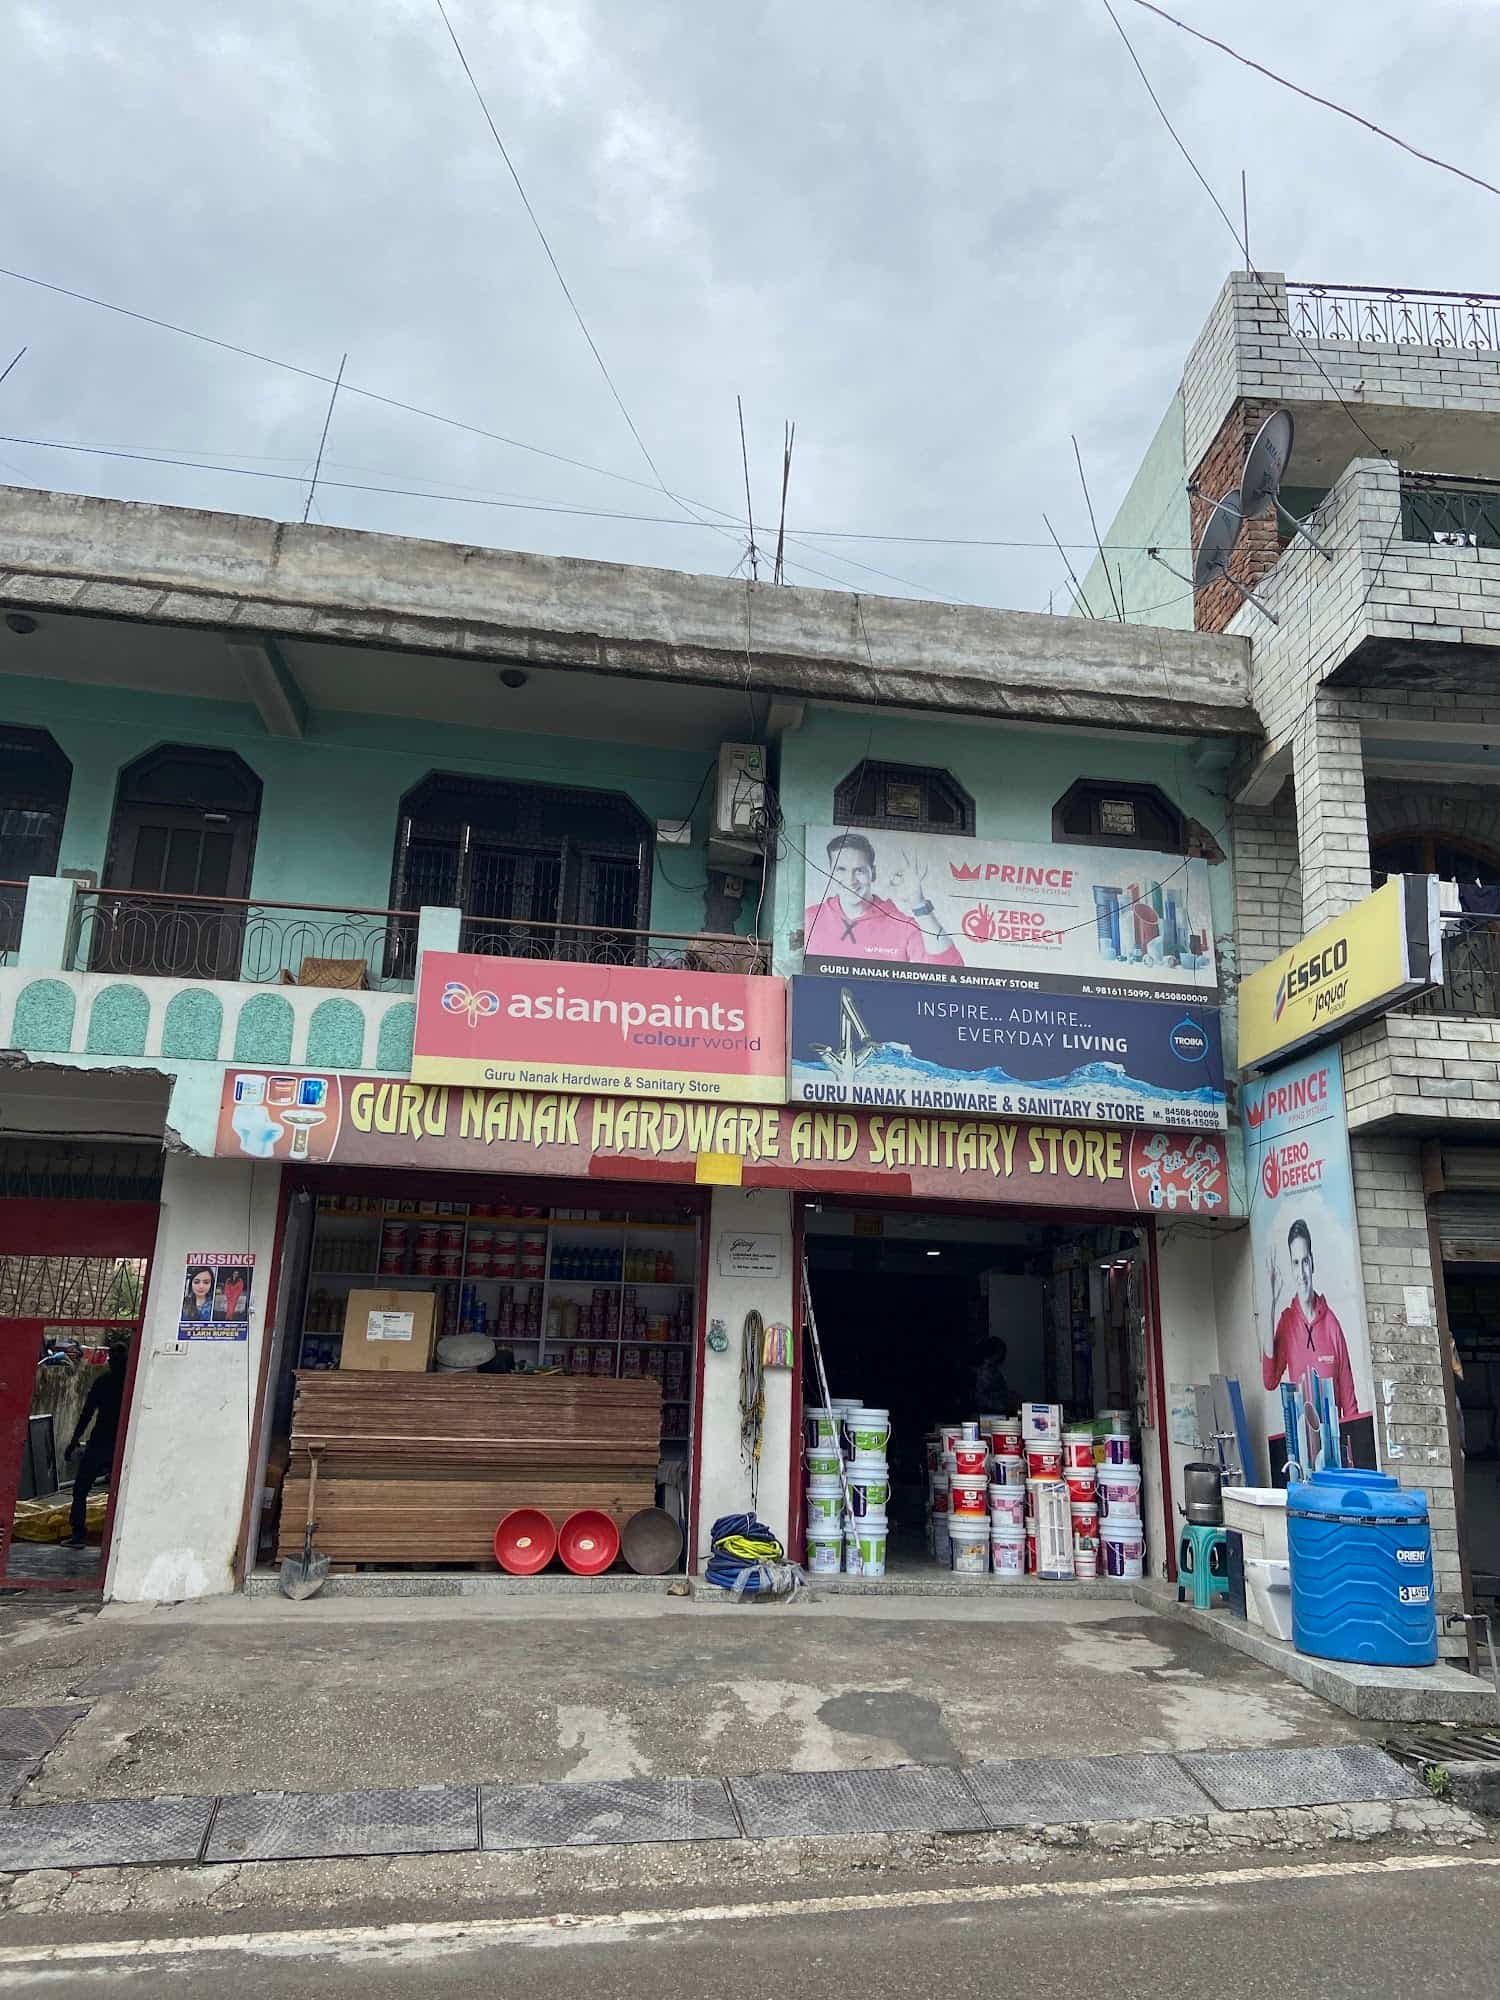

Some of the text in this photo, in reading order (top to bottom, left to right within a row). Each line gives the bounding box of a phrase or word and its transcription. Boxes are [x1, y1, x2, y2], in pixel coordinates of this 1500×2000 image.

[985, 864, 1073, 888] PRINCE
[998, 910, 1045, 926] ZERO
[998, 926, 1066, 945] DEFECT
[820, 965, 1040, 990] GURU NANAK HARDWARE & SANITARY STORE
[1288, 938, 1347, 999] ESSCO
[1082, 985, 1093, 993] M.
[1095, 986, 1152, 999] 9816115099,
[507, 987, 745, 1040] asianpaints
[918, 1001, 1092, 1028] INSPIRE... ADMIRE...
[958, 1026, 1128, 1053] EVERYDAY LIVING
[484, 1068, 720, 1093] Guru Nanak Hardware & Sanitary Store
[803, 1083, 1144, 1121] GURU NANAK HARDWARE & SANITARY STORE
[1267, 1069, 1328, 1119] PRINCE
[1153, 1110, 1163, 1120] M.
[350, 1083, 1125, 1184] GURU NANAK HARDWARE AND SANITARY STORE
[1280, 1142, 1309, 1166] ZERO
[1281, 1160, 1324, 1188] DEFECT
[189, 1254, 254, 1265] MISSING
[1396, 1550, 1426, 1561] ORIENT
[1400, 1587, 1428, 1600] 3 LAYER
